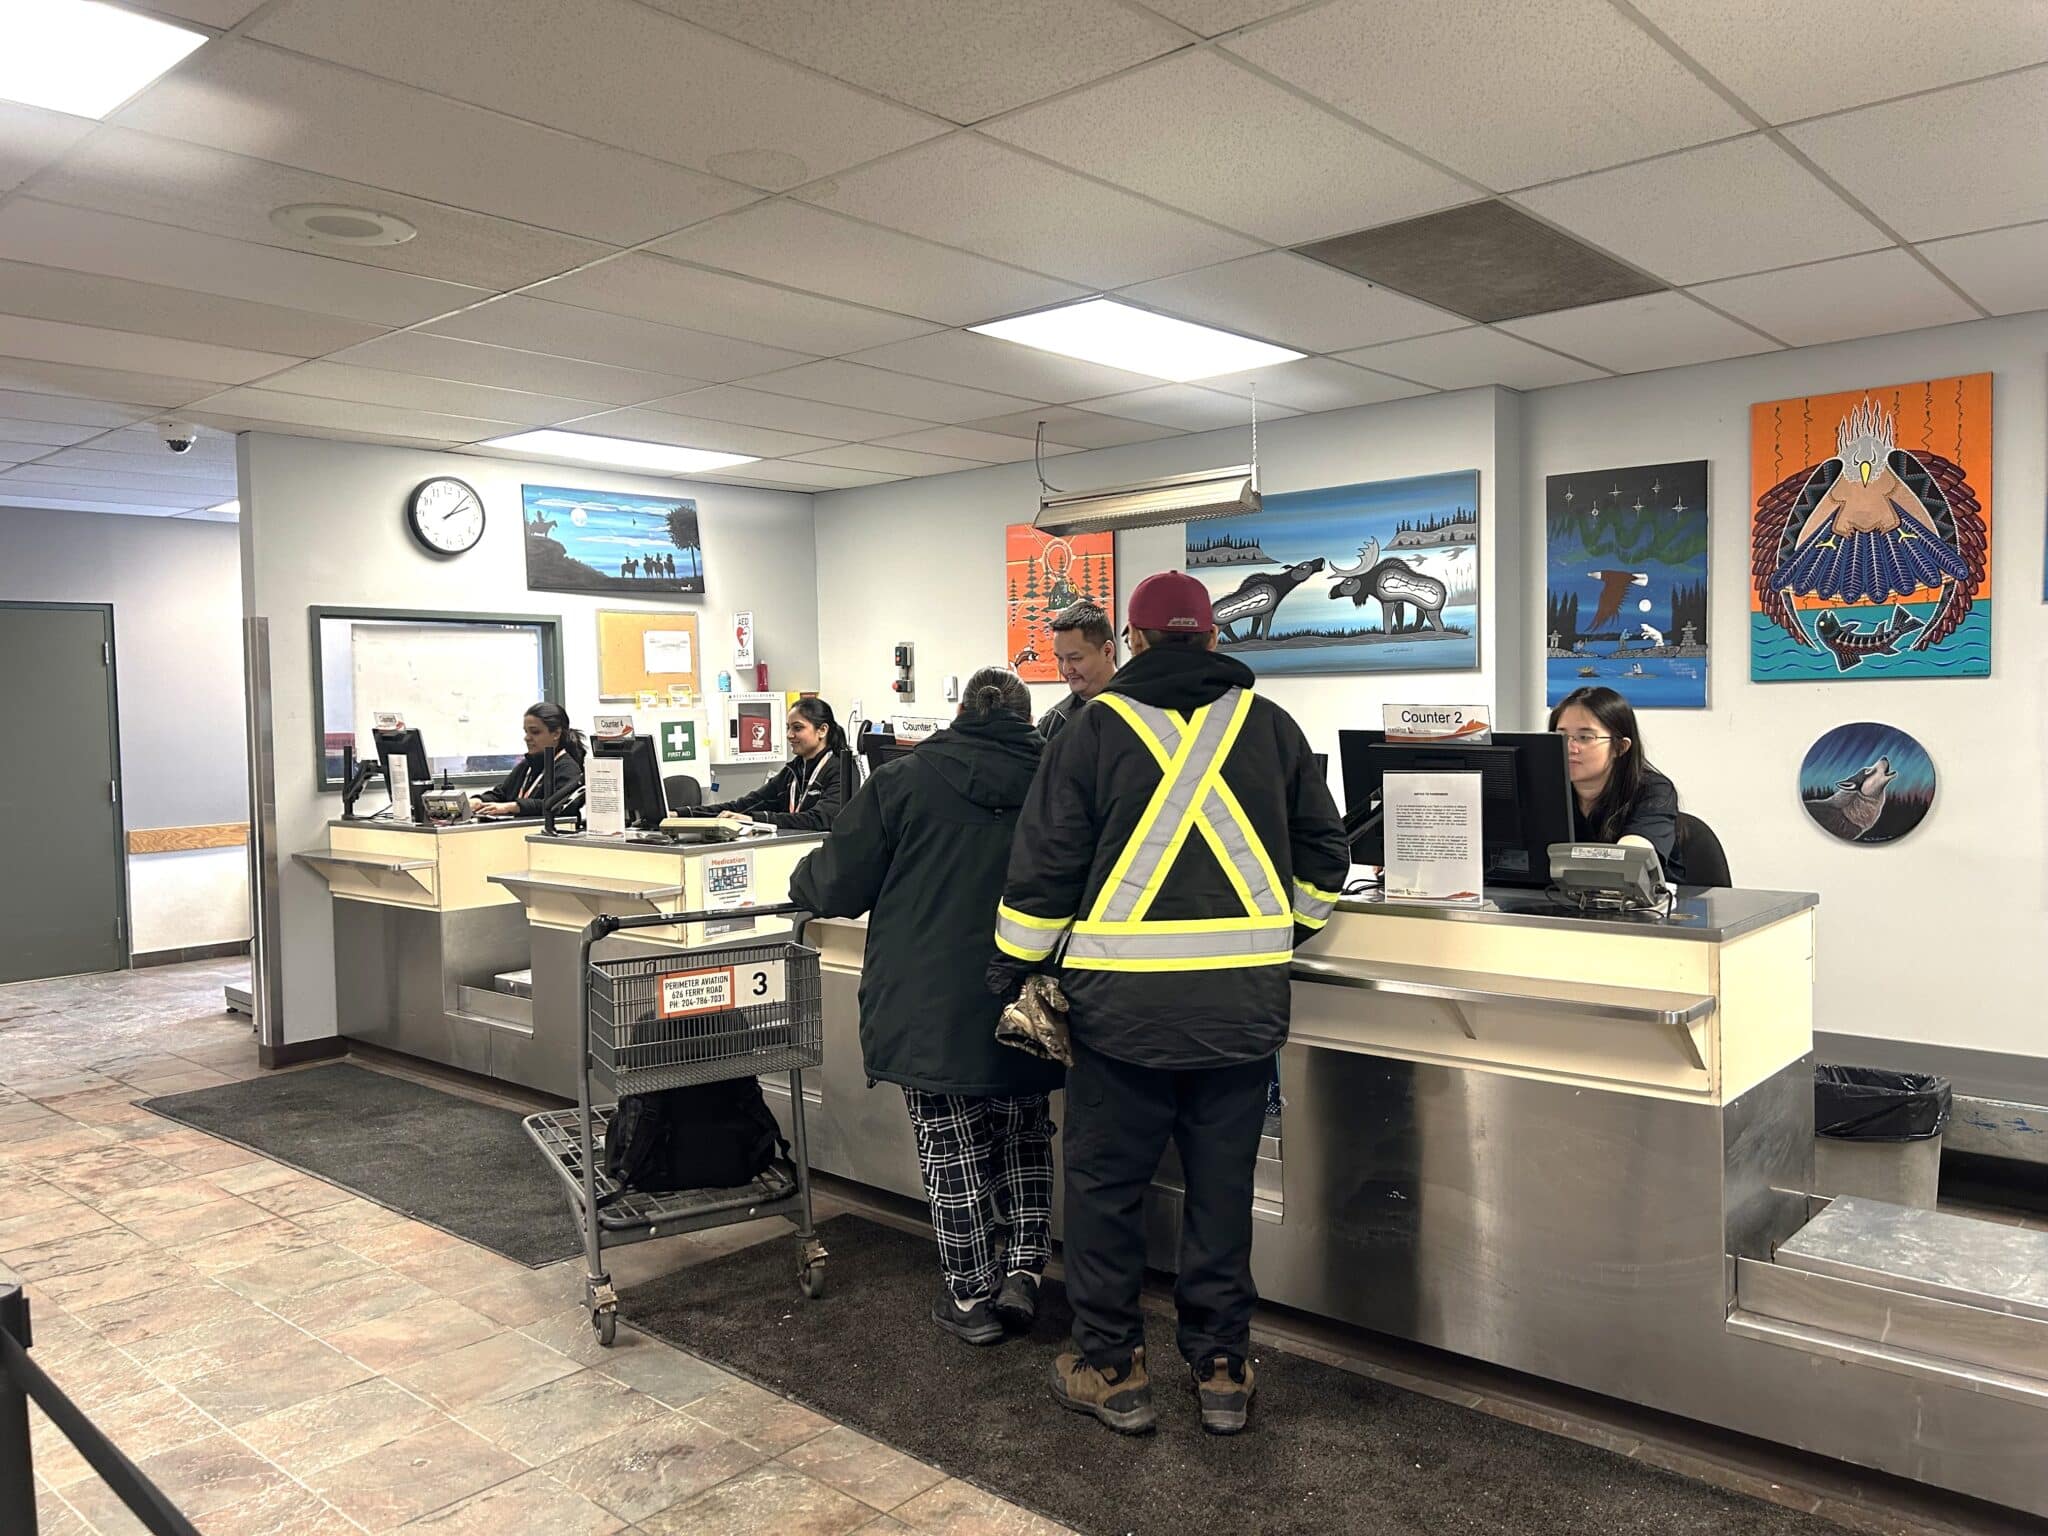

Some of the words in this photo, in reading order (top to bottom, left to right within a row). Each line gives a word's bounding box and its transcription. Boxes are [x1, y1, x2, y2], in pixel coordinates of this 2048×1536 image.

[738, 617, 749, 626] AED
[738, 649, 749, 657] DEA
[1401, 710, 1451, 724] Counter
[1454, 711, 1463, 724] 2
[600, 720, 620, 728] Counter
[902, 721, 932, 731] Counter
[933, 722, 938, 732] 3
[711, 857, 746, 866] Medication
[664, 978, 700, 990] PERIMETER
[701, 975, 729, 986] AVIATION
[752, 971, 768, 996] 3
[671, 990, 684, 999] 626
[685, 987, 704, 997] FERRY
[706, 985, 723, 994] ROAD
[681, 994, 725, 1008] 204-786-7031
